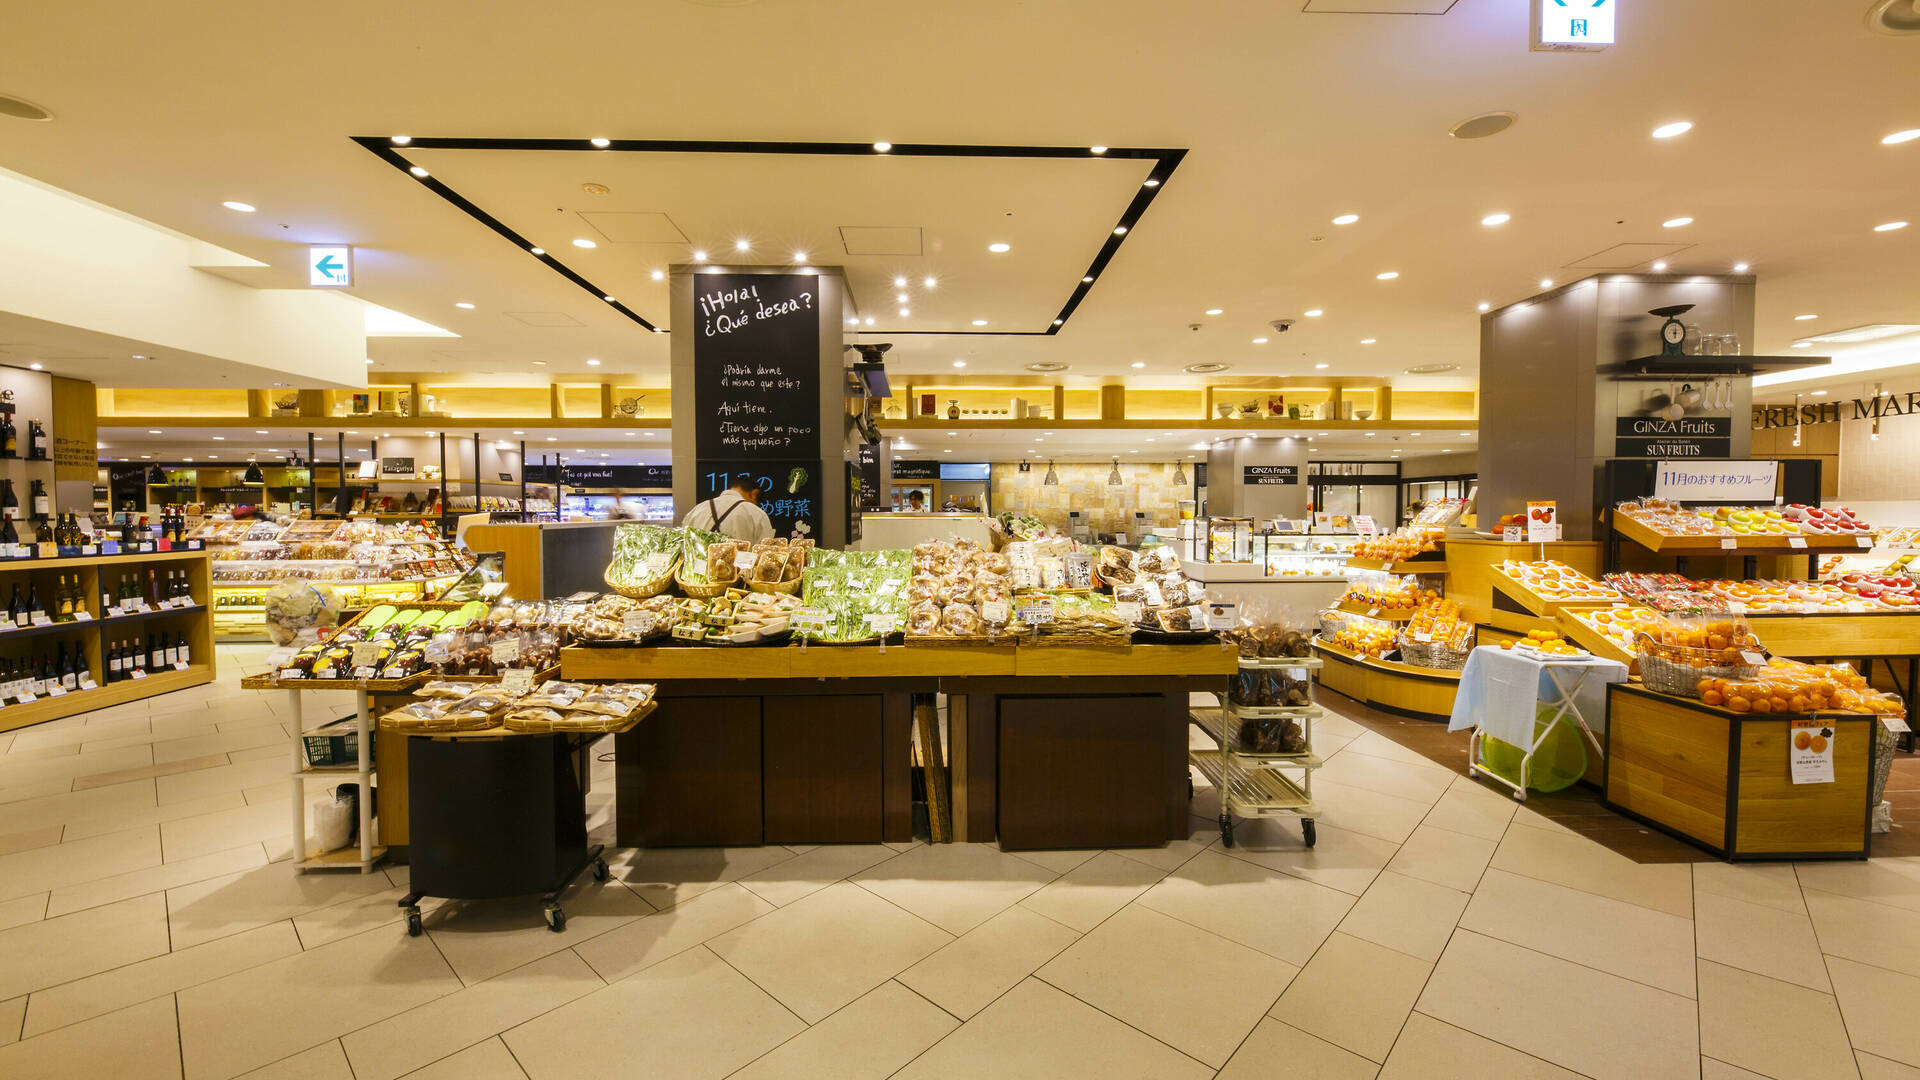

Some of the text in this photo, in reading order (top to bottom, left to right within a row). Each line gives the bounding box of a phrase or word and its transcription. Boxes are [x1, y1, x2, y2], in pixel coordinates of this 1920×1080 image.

[700, 285, 760, 317] ¡Hola!
[705, 309, 749, 337] ¿Qué
[757, 364, 782, 375] darme
[760, 380, 774, 392] que
[718, 401, 740, 416] Aquí
[1751, 401, 1842, 430] FRESH
[720, 421, 750, 433] ¿Tiene
[754, 423, 769, 435] algo
[788, 426, 812, 435] poco
[1634, 420, 1715, 434] GINZA Fruits
[723, 435, 740, 444] más
[1274, 466, 1291, 474] Fruits
[706, 472, 773, 492] 11の
[1663, 471, 1773, 487] 11月のおすすめフルーツ
